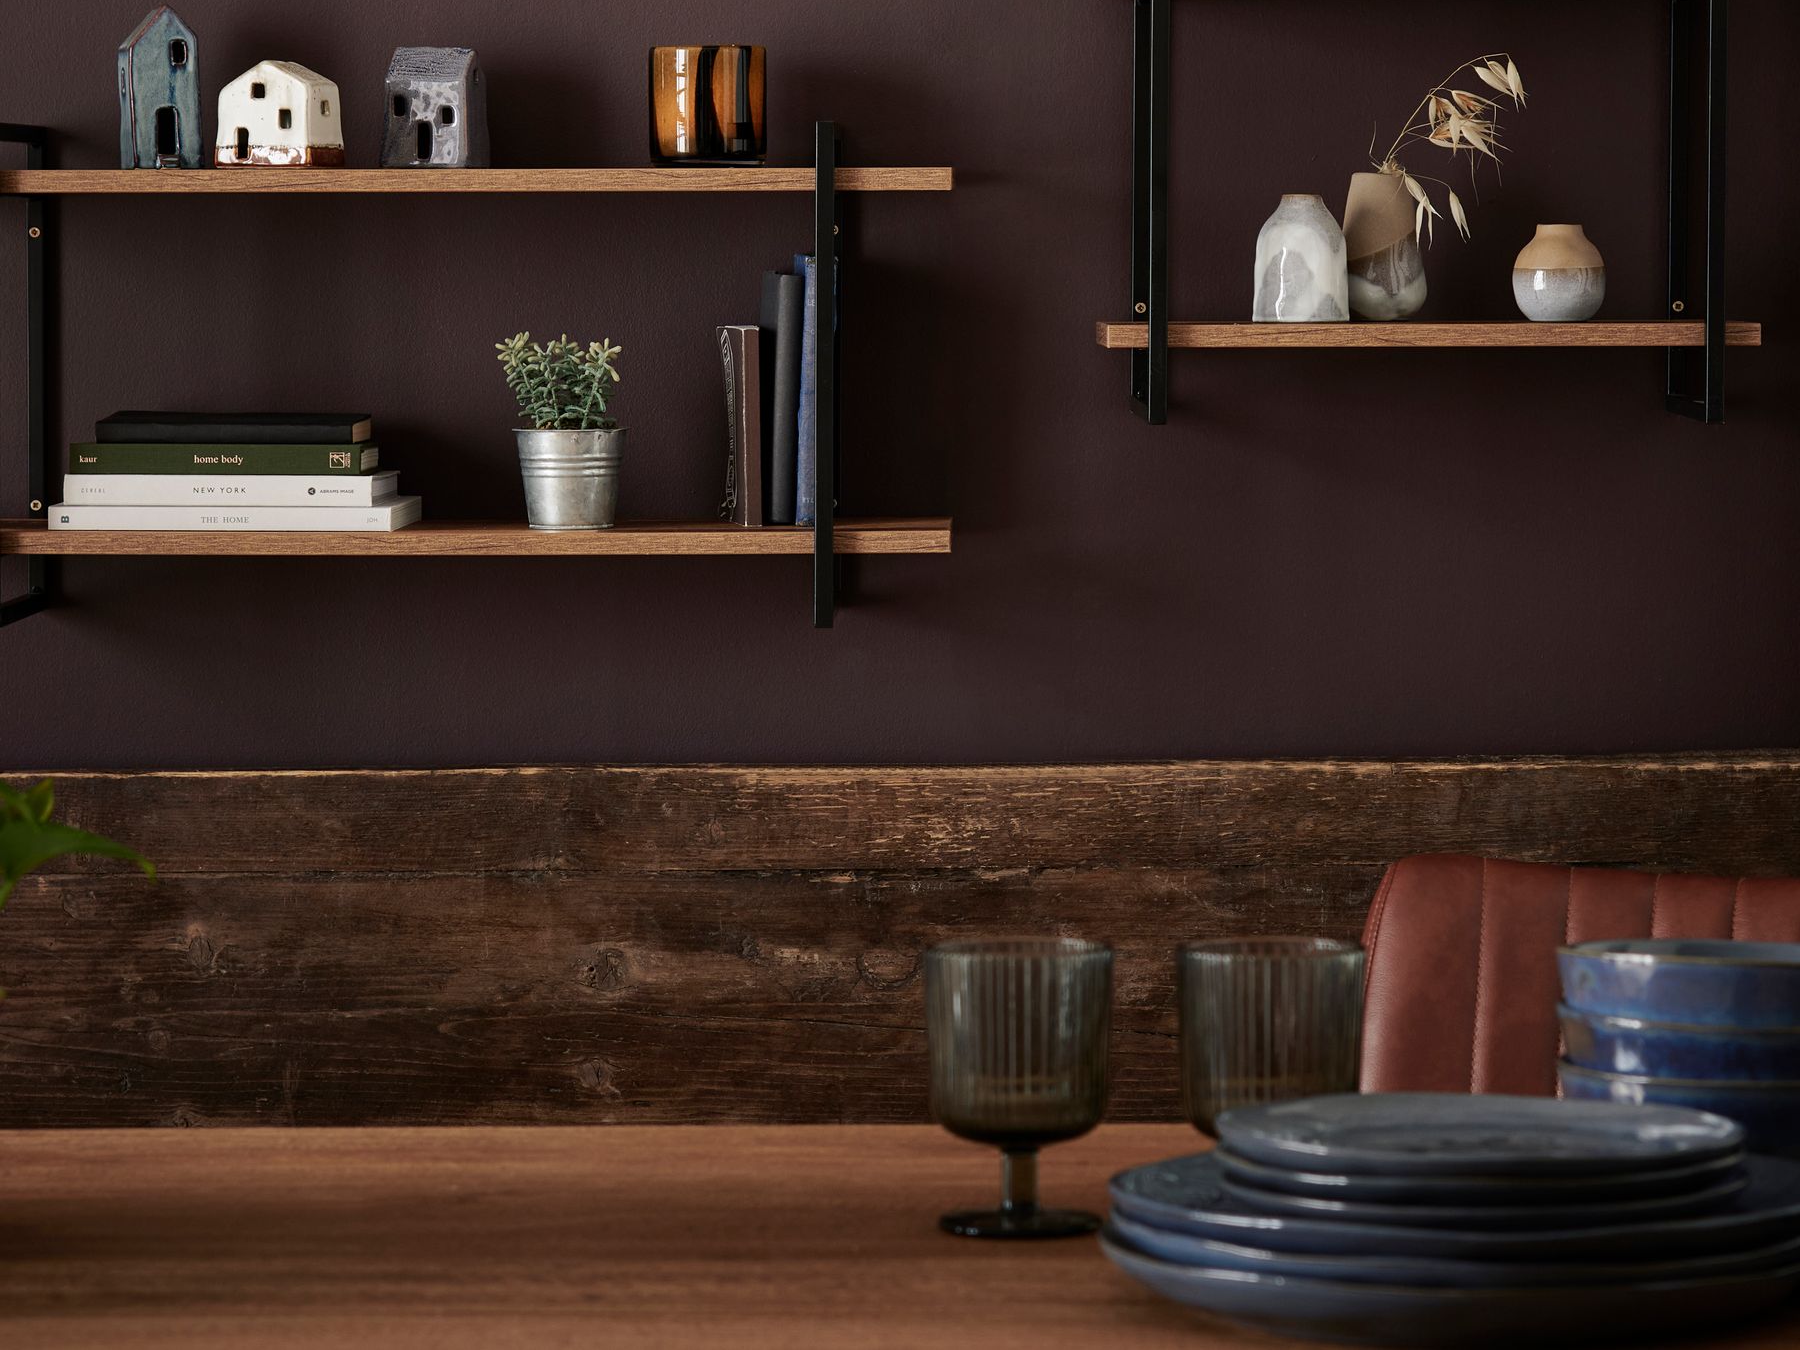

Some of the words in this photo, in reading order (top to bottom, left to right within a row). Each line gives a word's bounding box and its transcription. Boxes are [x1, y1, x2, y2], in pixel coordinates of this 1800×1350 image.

[79, 455, 97, 464] kaur
[193, 454, 219, 464] home
[221, 454, 244, 466] body
[200, 516, 218, 524] THE
[223, 516, 249, 524] HOME
